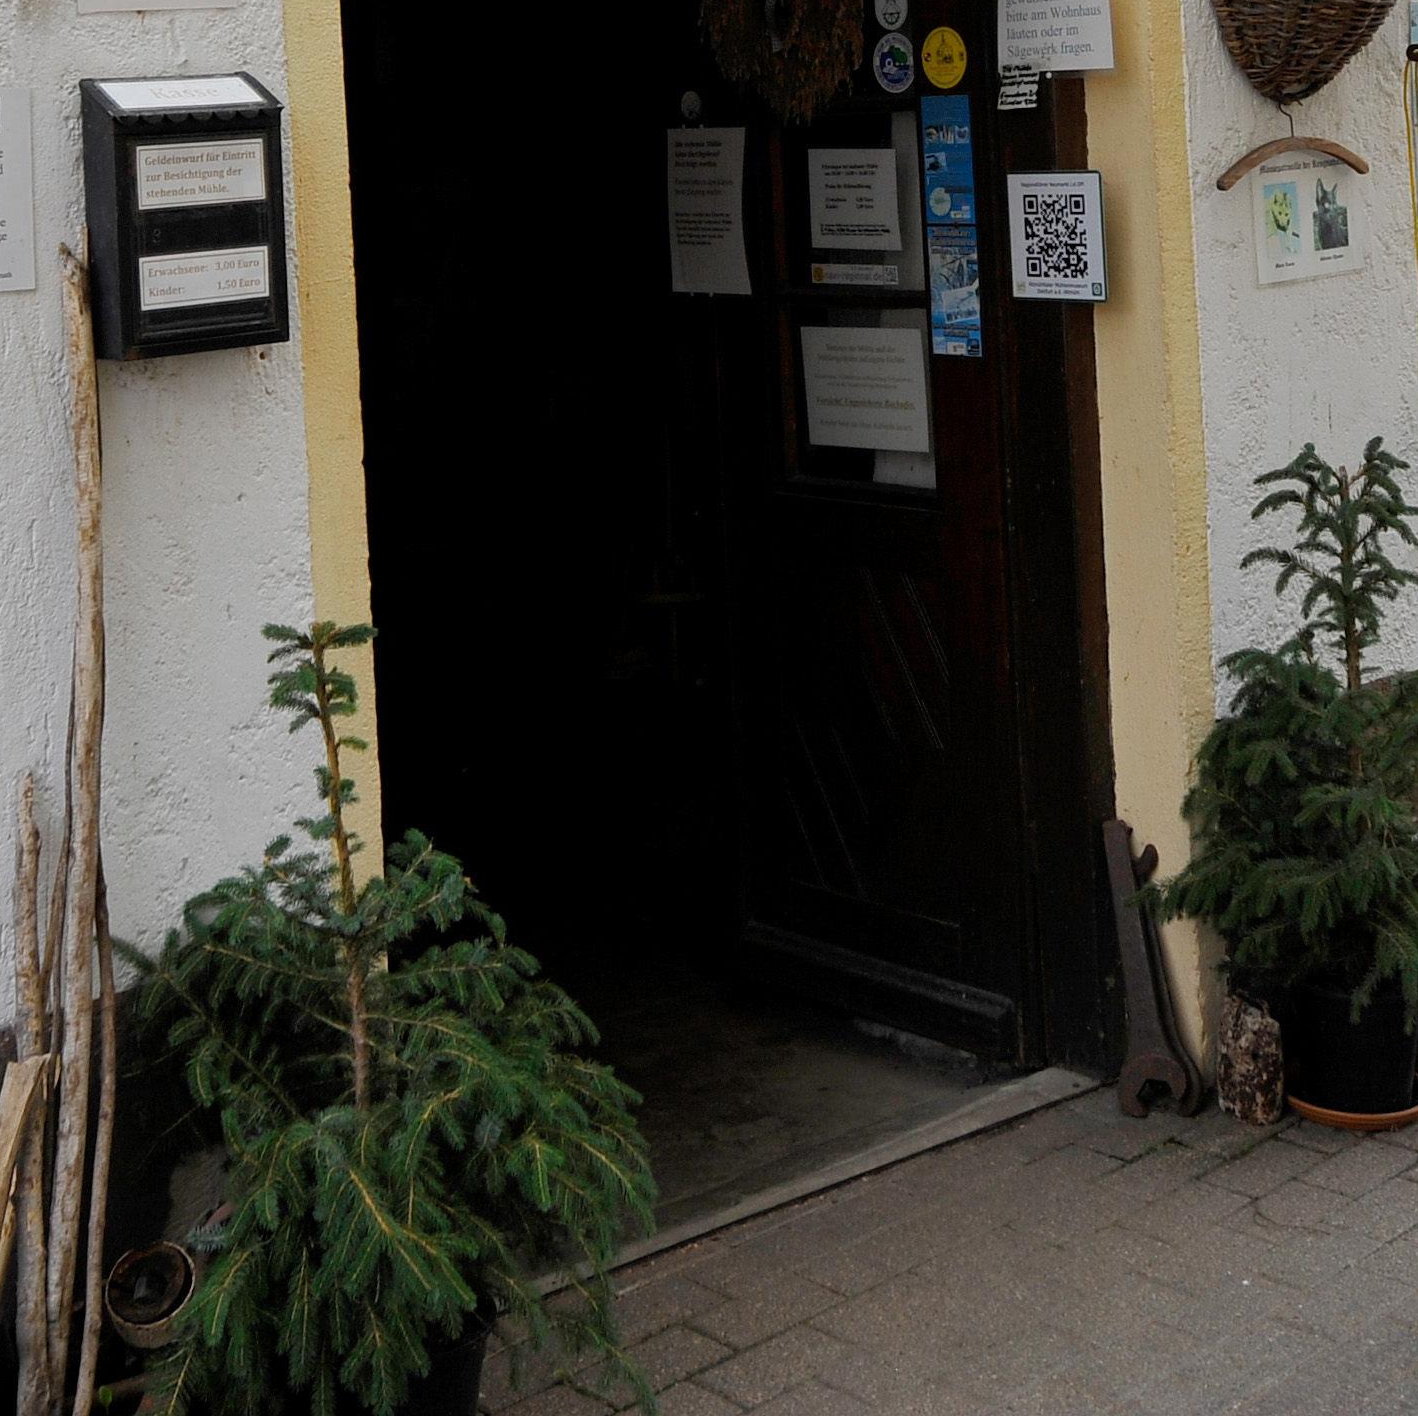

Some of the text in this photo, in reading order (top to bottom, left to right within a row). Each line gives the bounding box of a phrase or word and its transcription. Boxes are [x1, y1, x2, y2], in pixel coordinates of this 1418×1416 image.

[1006, 4, 1101, 22] bitte am Wohnhaus
[1006, 24, 1079, 40] läuten oder im
[1007, 41, 1095, 59] Sägewerk fragen.
[149, 87, 220, 99] Kasse
[144, 150, 256, 167] Geldeinwurf für Eintritt
[146, 167, 242, 183] zur Besichtigung der
[146, 183, 229, 198] stehenden Mühle.
[148, 258, 259, 278] Erwachsene: 3,00 Euro
[148, 278, 261, 298] Kinder: 1,50 Euro
